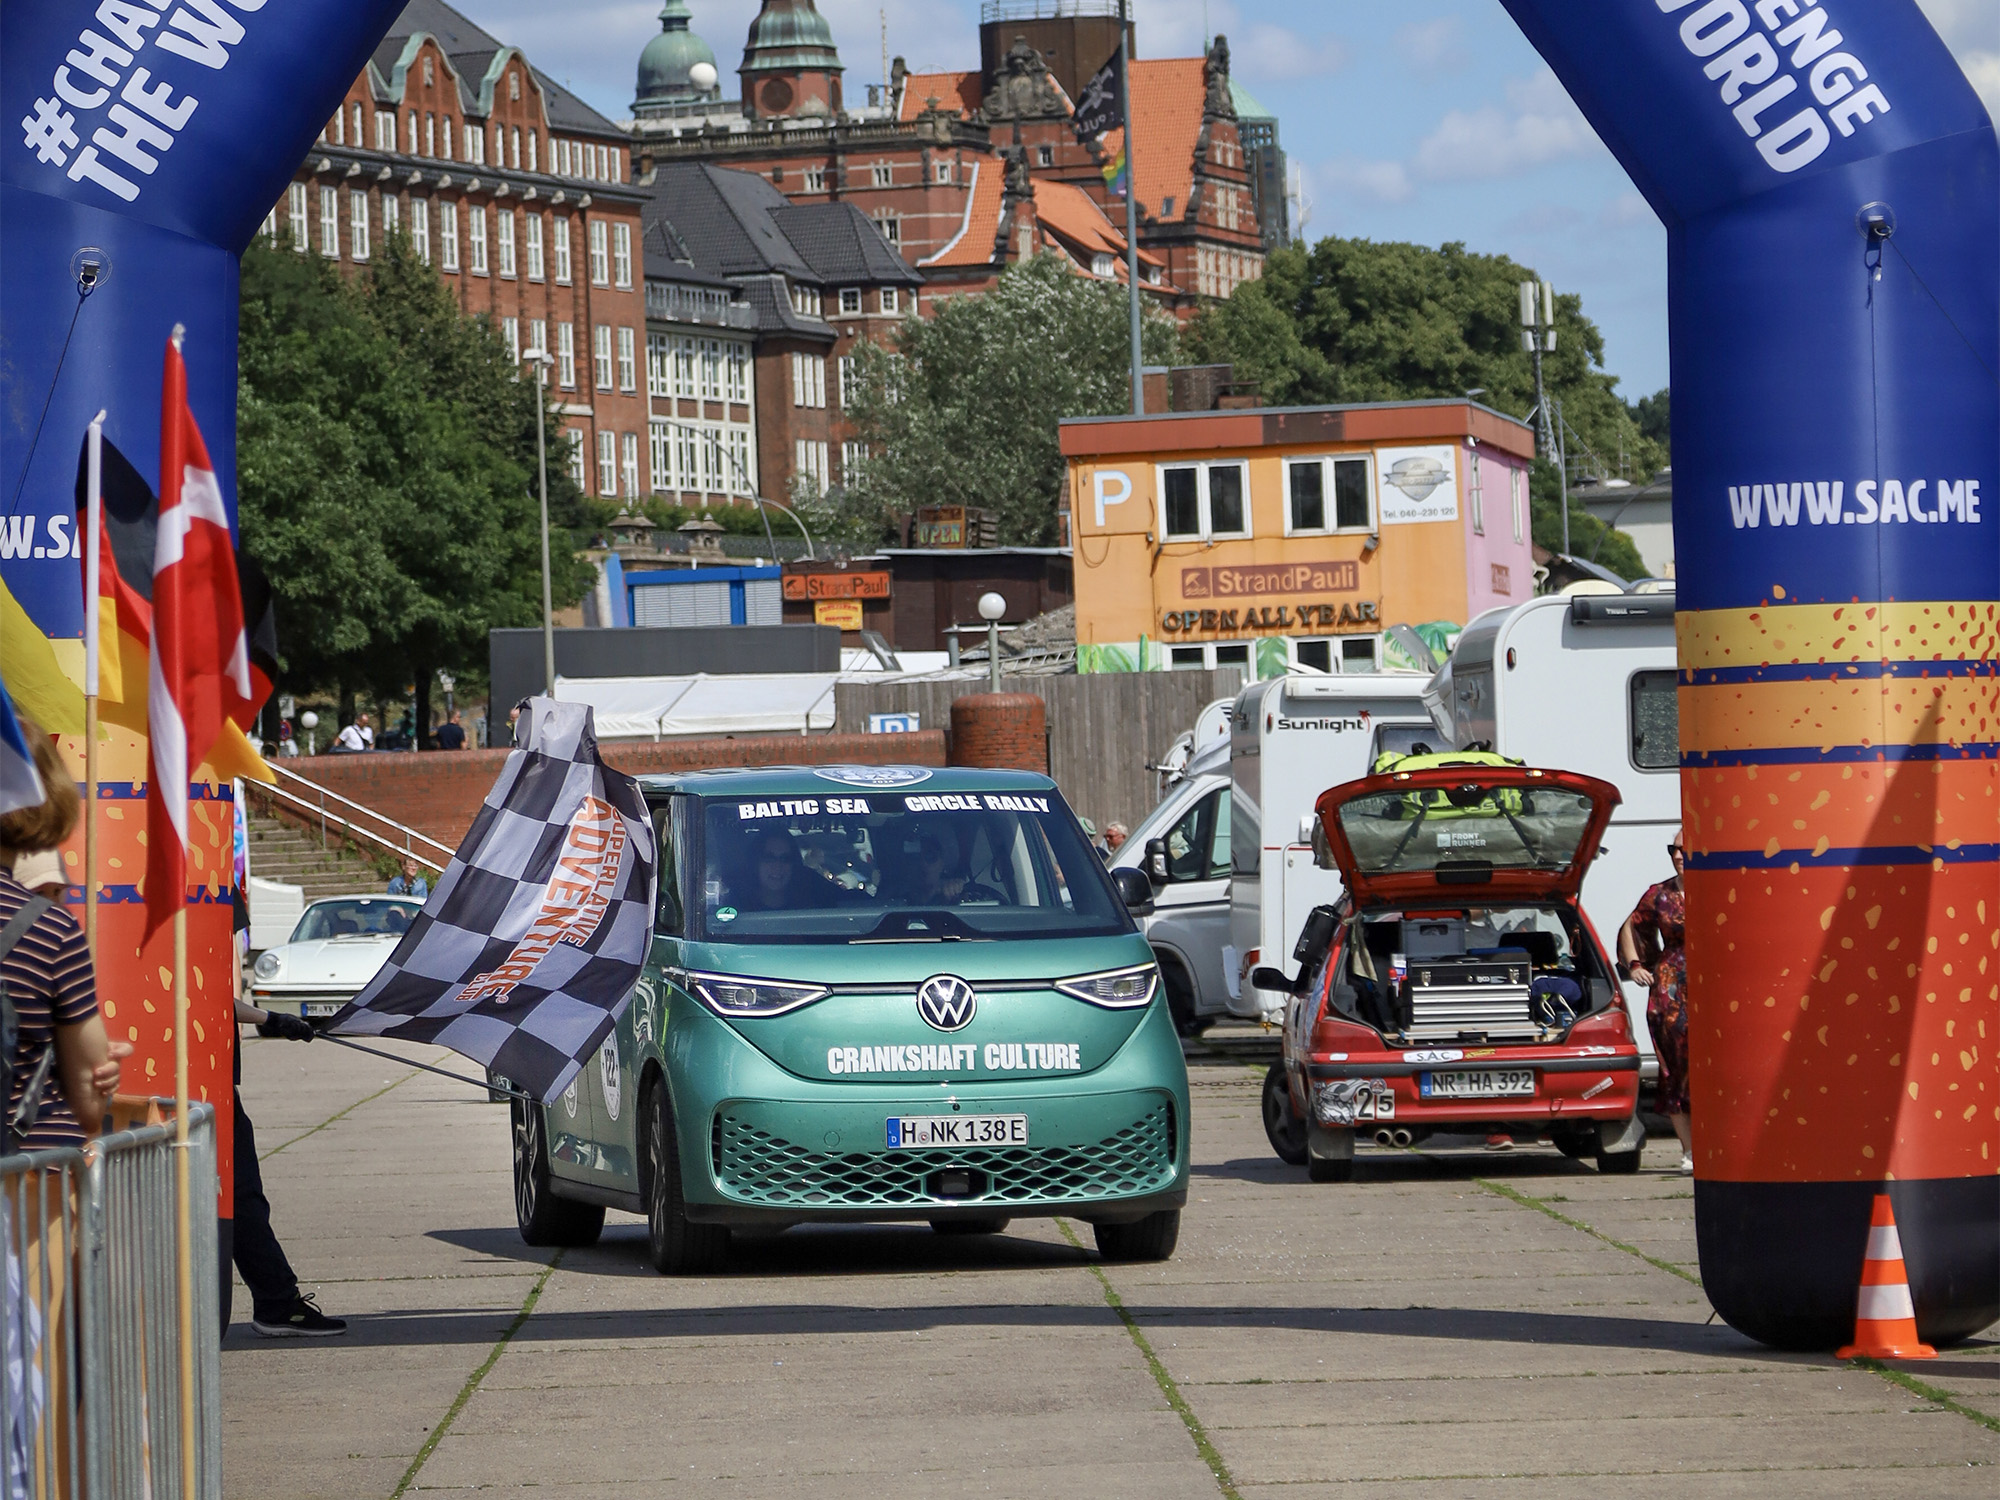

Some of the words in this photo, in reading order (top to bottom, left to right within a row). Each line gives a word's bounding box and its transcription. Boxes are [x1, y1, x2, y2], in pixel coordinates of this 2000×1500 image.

[21, 0, 173, 168] #CHA
[1656, 0, 1831, 173] ORLD
[66, 66, 200, 203] THE
[154, 0, 269, 71] W
[1094, 471, 1132, 526] P
[1383, 510, 1399, 519] Tel.
[1441, 507, 1456, 516] 120
[1729, 479, 1981, 529] WWW.SAC.ME
[0, 515, 81, 559] W.S
[919, 523, 961, 545] OPEN
[1218, 564, 1355, 594] StrandPauli
[1162, 609, 1238, 633] OPEN
[1242, 605, 1294, 630] ALL
[1297, 601, 1379, 626] YEAR
[1278, 718, 1364, 734] Sunlight
[738, 799, 819, 820] BALTIC
[826, 798, 871, 815] SEA
[904, 794, 982, 812] CIRCLE
[983, 794, 1050, 813] RALLY
[1452, 832, 1480, 840] FRONT
[1452, 839, 1487, 847] RUNNER
[455, 971, 487, 1001] CLUB
[827, 1044, 978, 1074] CRANKSHAFT
[984, 1042, 1081, 1071] CULTURE
[1432, 1072, 1456, 1093] NR
[1469, 1072, 1494, 1092] HA
[1498, 1071, 1534, 1091] 392
[1358, 1087, 1394, 1118] 25
[902, 1120, 917, 1144] H
[932, 1120, 961, 1143] NK
